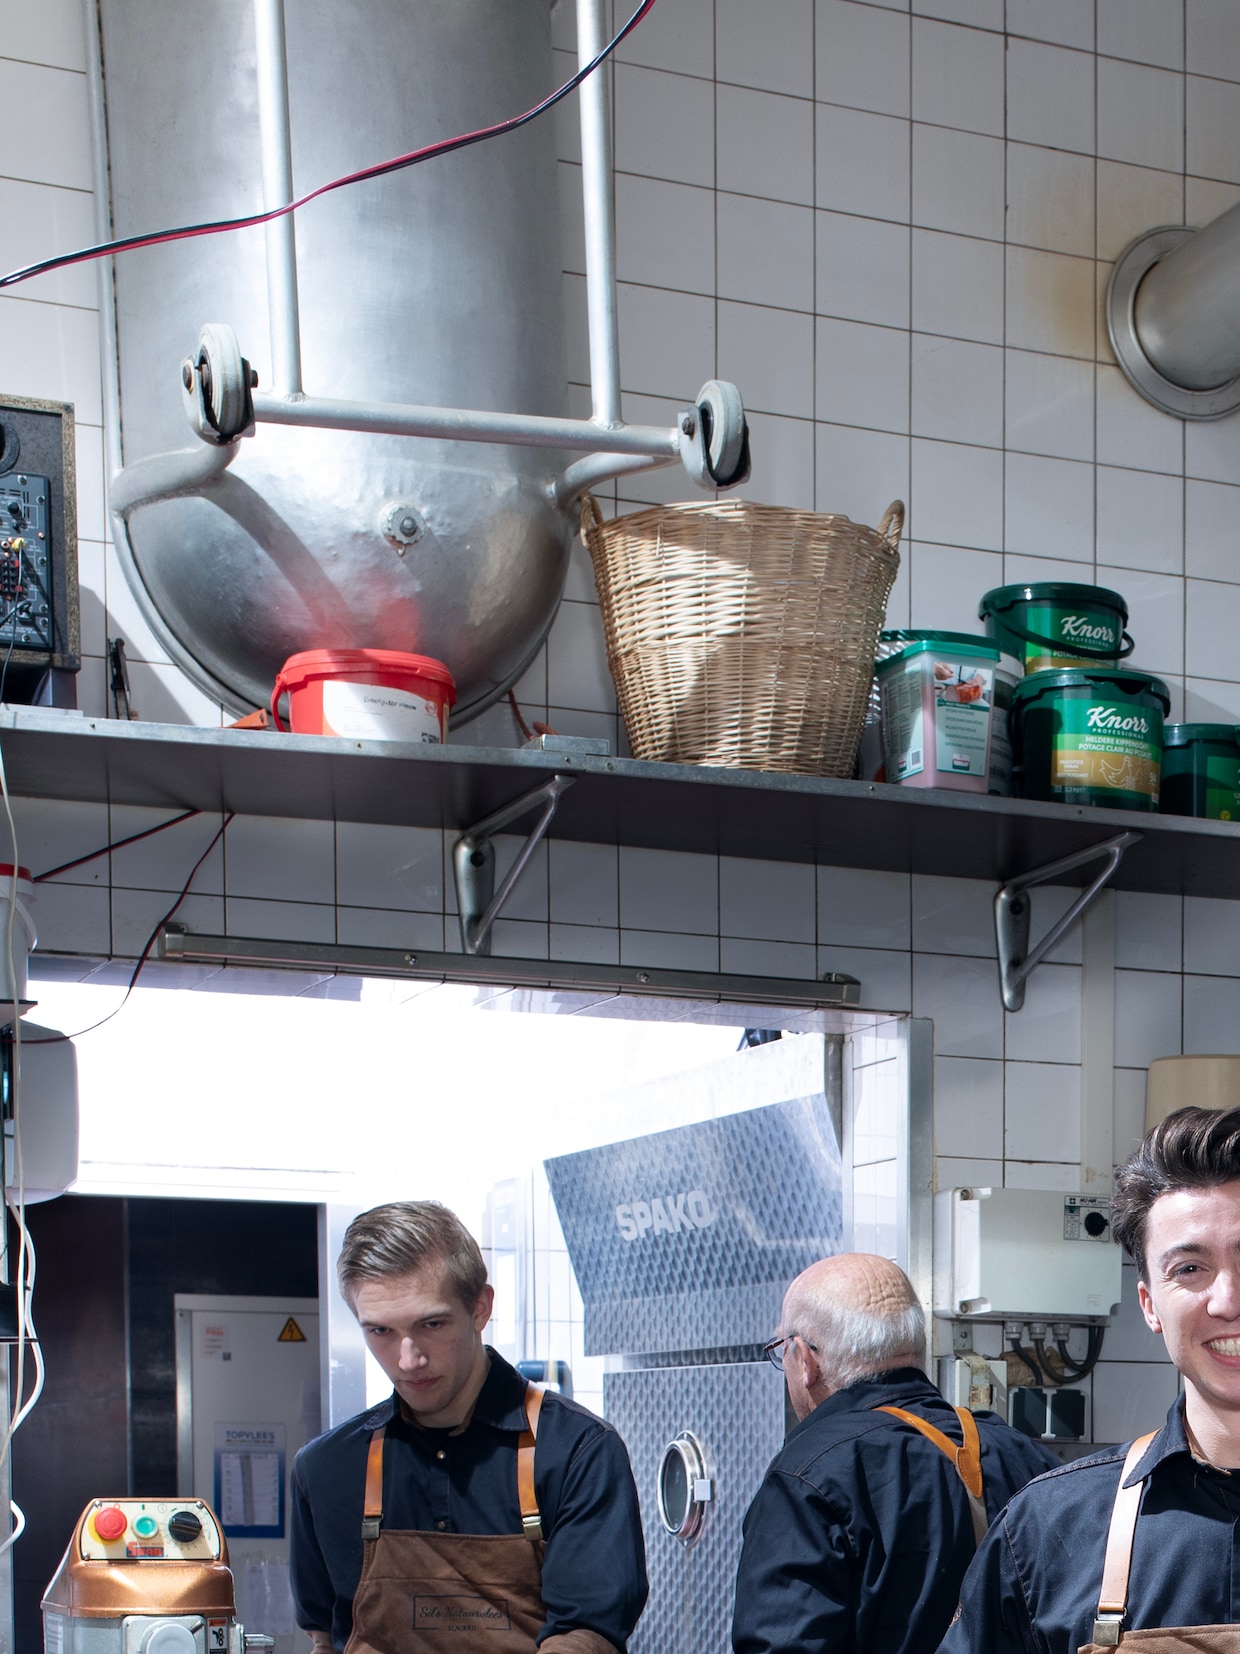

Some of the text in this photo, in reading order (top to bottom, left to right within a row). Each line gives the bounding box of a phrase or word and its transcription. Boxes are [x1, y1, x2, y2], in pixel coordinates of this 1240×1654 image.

[1060, 616, 1114, 642] Knorr
[1086, 706, 1149, 733] Knorr
[1085, 736, 1114, 745] HELDERE
[1092, 728, 1145, 739] PROFESSIONAL
[614, 1190, 716, 1242] SPAKO
